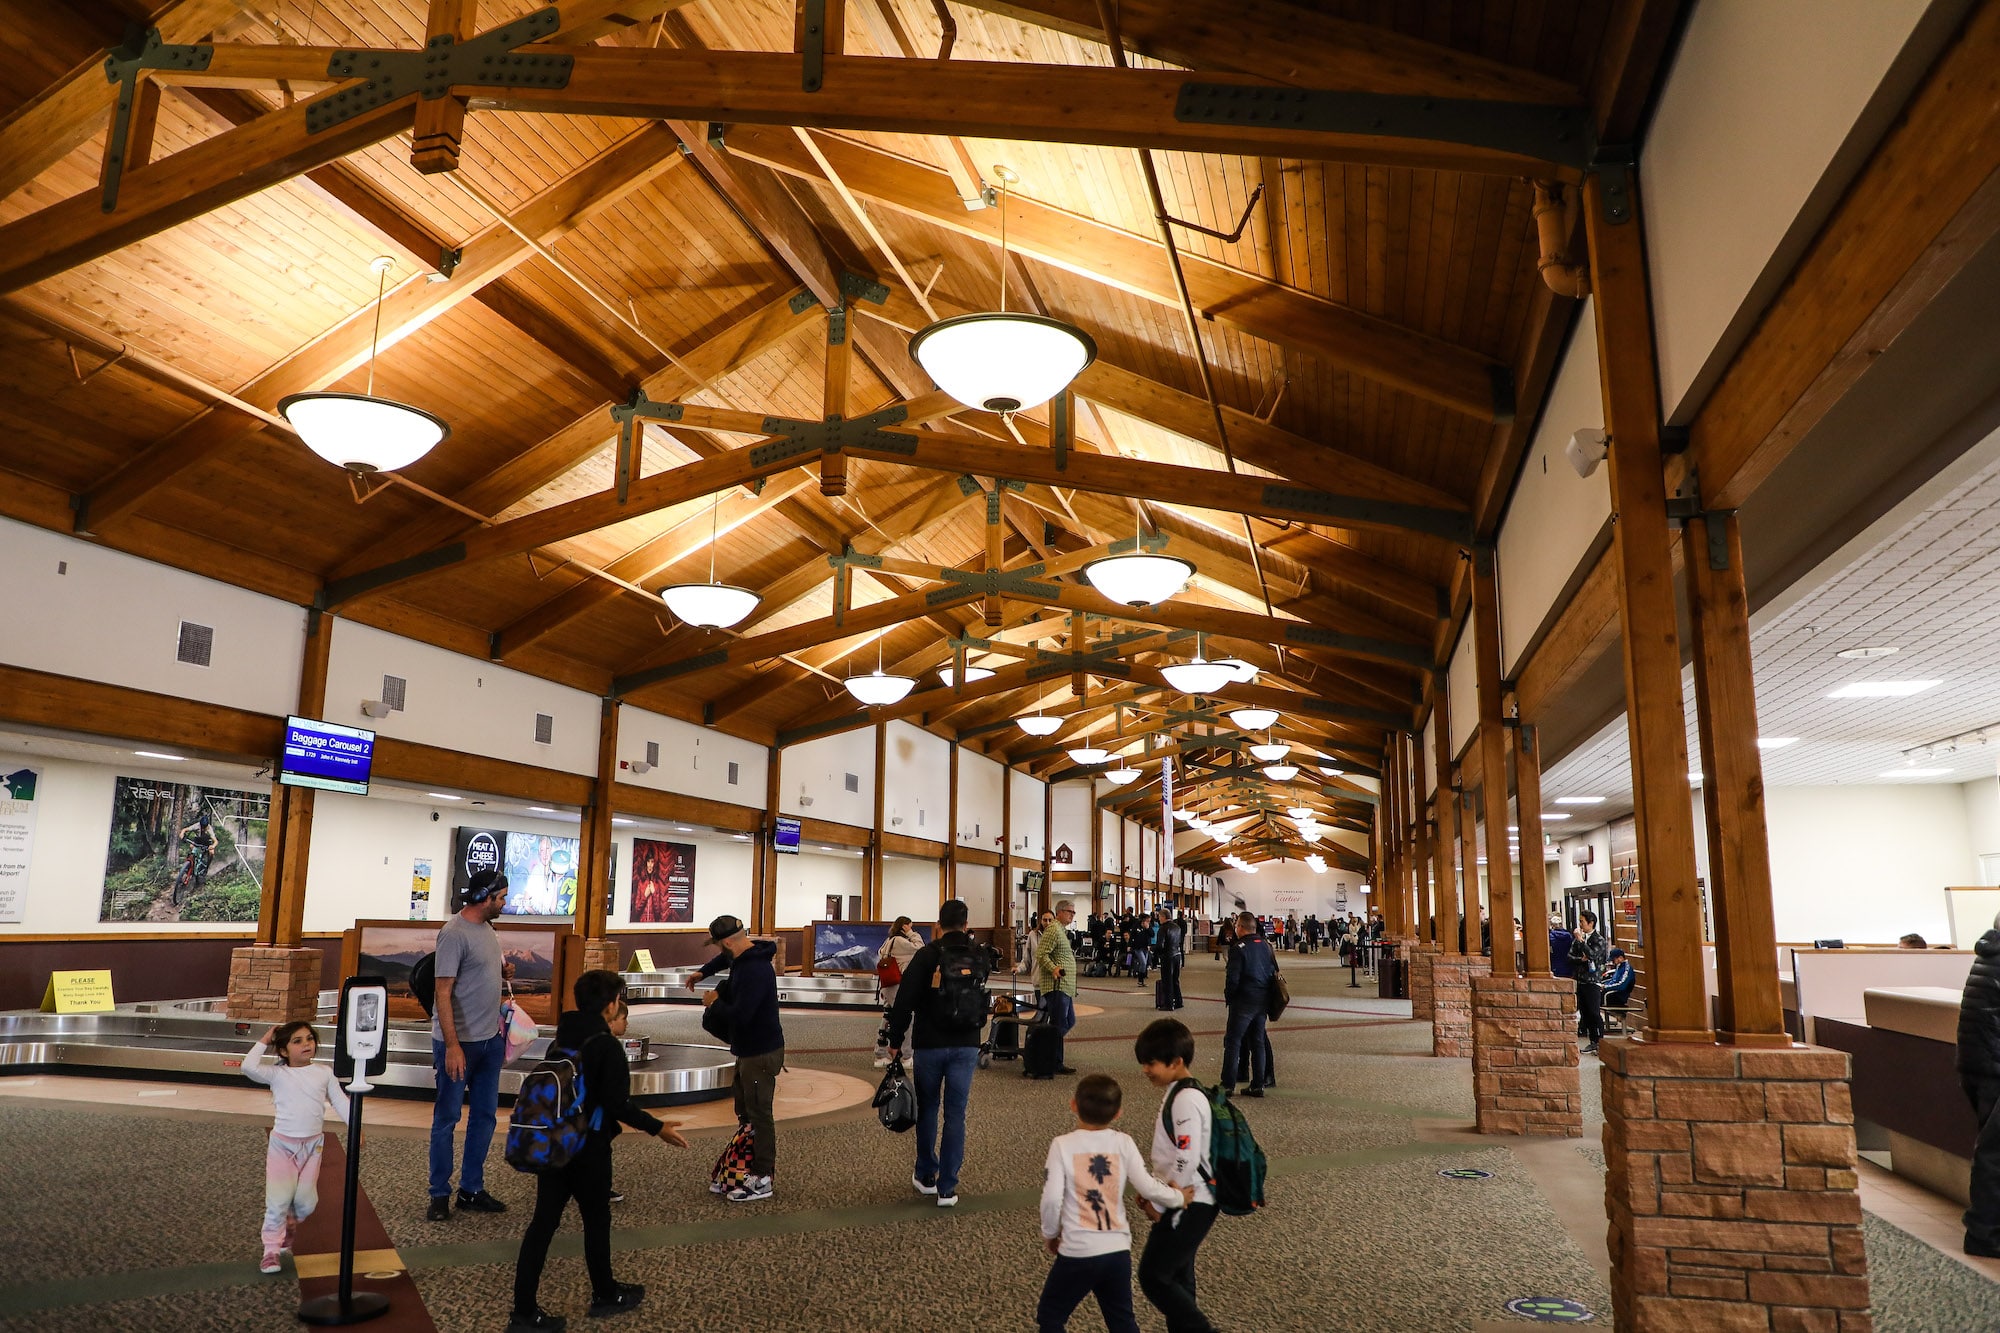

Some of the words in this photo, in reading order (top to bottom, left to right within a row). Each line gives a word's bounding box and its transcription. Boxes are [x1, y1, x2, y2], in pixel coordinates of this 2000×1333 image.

[292, 731, 327, 747] Baggage
[329, 738, 362, 753] Carousel
[363, 744, 370, 754] 2
[139, 787, 175, 799] REVEL
[472, 842, 489, 851] MEAT
[489, 843, 494, 852] &
[471, 851, 494, 861] CHEESE
[1275, 894, 1302, 902] Cartier
